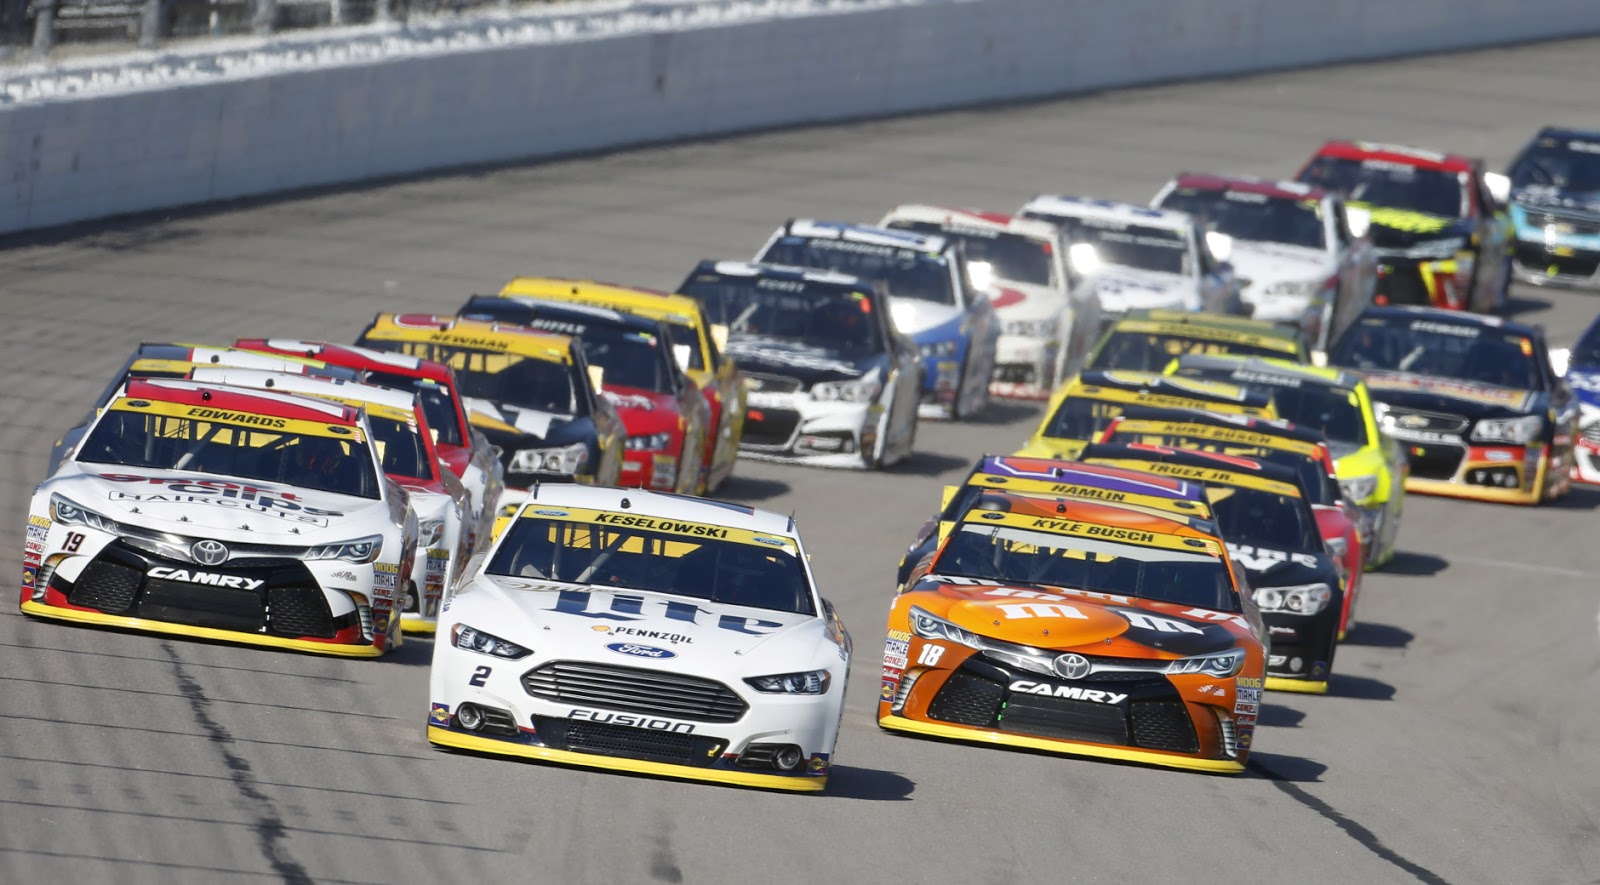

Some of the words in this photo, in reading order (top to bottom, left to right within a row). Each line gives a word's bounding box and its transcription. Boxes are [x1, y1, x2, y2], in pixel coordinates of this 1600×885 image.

[430, 333, 509, 350] NEWMAN
[187, 408, 287, 428] EDWARDS
[1149, 463, 1206, 478] TRUEX
[1051, 484, 1126, 501] HAMLIN
[118, 492, 319, 523] HAIRCUTS
[29, 514, 52, 528] MOOG
[594, 512, 728, 539] KESELOWSKI
[1032, 519, 1081, 533] KYLE
[1086, 526, 1154, 543] BUSCH
[61, 531, 87, 553] 19
[374, 562, 399, 574] MOOG
[147, 566, 265, 590] CAMRY
[540, 590, 784, 636] Lite
[995, 603, 1090, 620] m
[614, 626, 694, 644] PENNZOIL
[887, 629, 913, 642] MOOG
[885, 641, 909, 655] MAHLE
[917, 643, 946, 667] 18
[468, 665, 492, 687] 2
[1235, 676, 1262, 688] MOOG
[1009, 680, 1128, 704] CAMRY
[1236, 688, 1261, 701] MAHLE
[567, 709, 696, 733] FUSION
